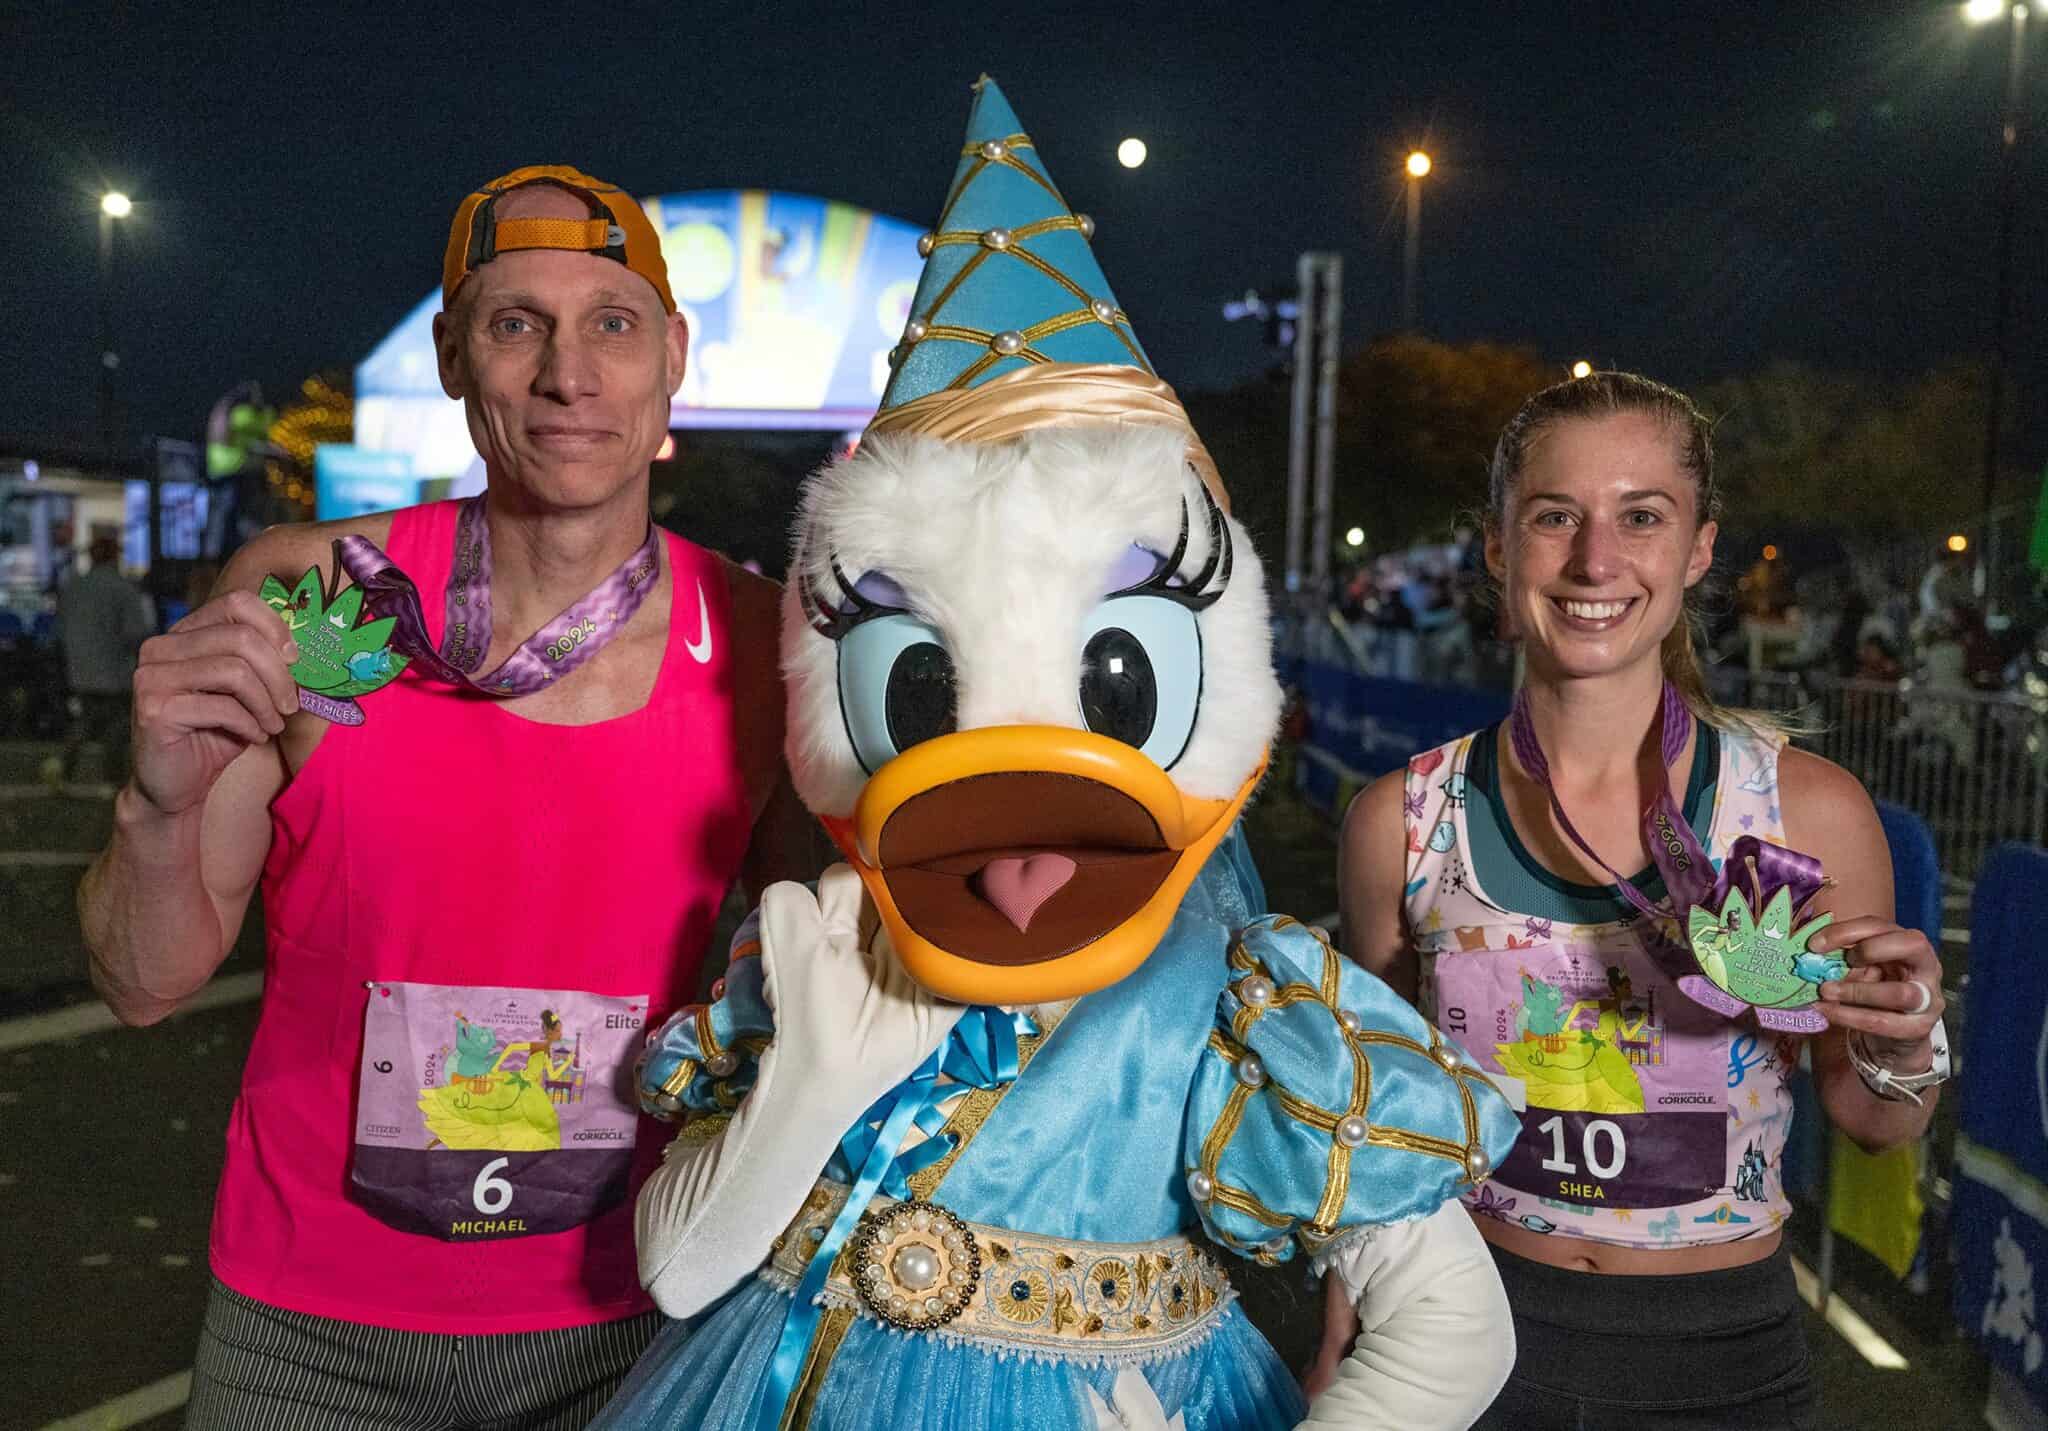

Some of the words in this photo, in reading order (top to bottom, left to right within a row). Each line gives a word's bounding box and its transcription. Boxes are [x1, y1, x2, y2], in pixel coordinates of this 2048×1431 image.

[546, 617, 596, 661] 2024
[323, 704, 358, 721] MILES
[1655, 815, 1691, 871] 2024
[605, 1014, 641, 1030] Elite
[1447, 1007, 1468, 1035] 10
[1496, 1008, 1507, 1041] 2024
[1785, 1015, 1822, 1028] MILES
[373, 1060, 393, 1074] 6
[423, 1053, 436, 1086] 2024
[1537, 1115, 1627, 1180] 10
[472, 1156, 514, 1215] 6
[1559, 1180, 1605, 1199] SHEA
[451, 1220, 528, 1235] MICHAEL
